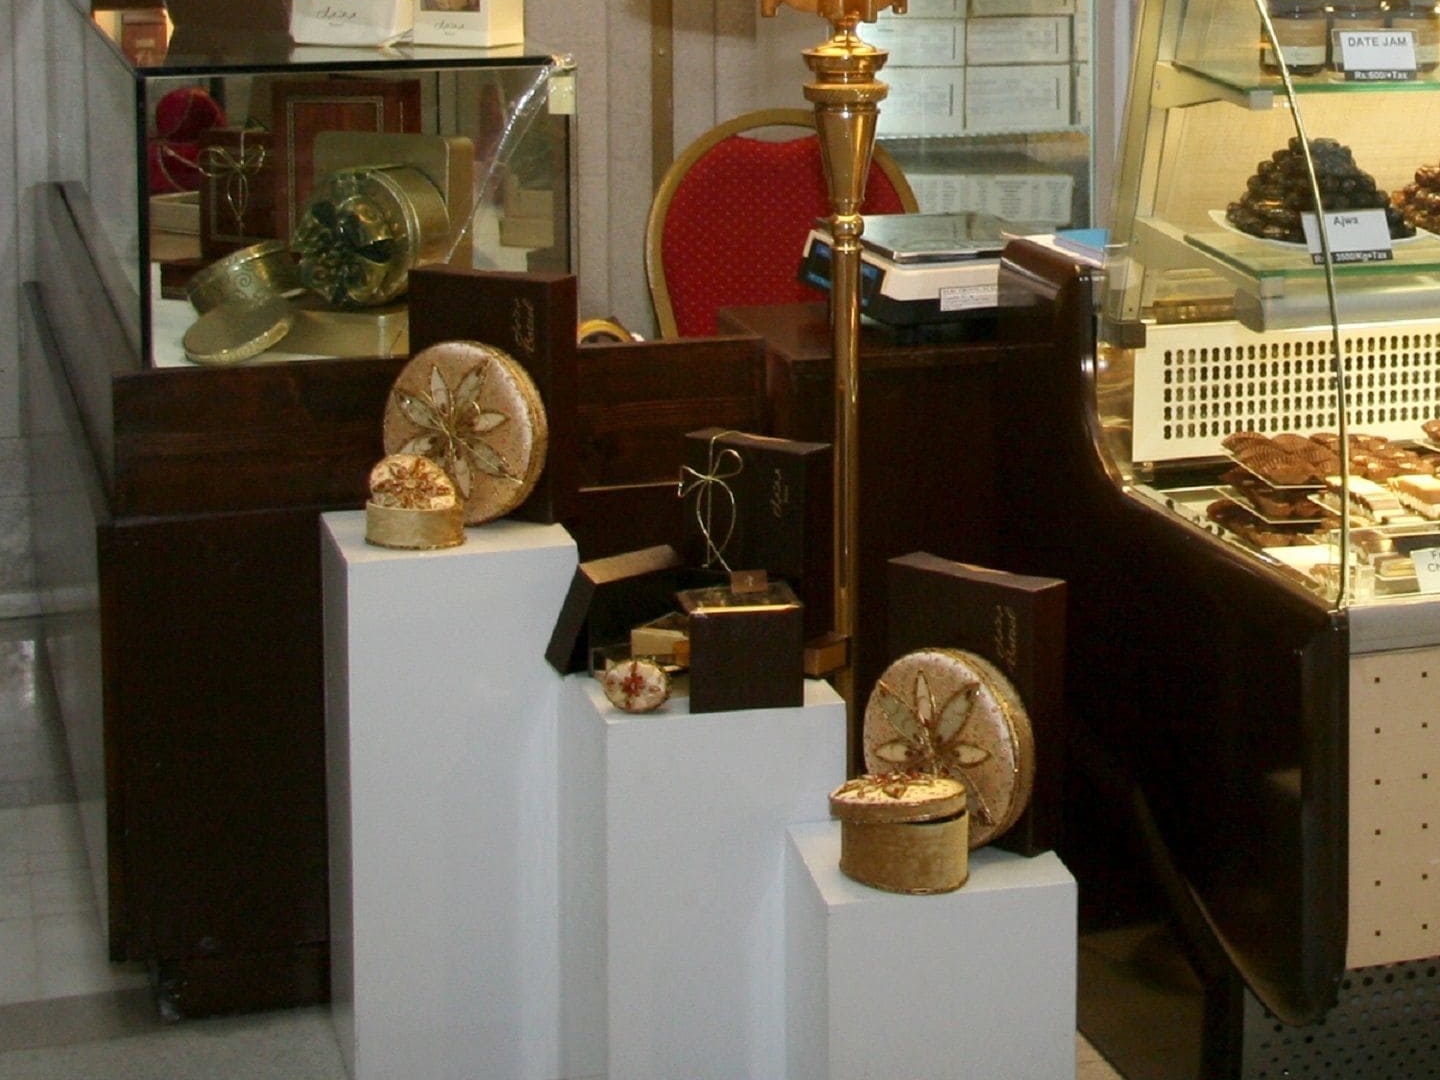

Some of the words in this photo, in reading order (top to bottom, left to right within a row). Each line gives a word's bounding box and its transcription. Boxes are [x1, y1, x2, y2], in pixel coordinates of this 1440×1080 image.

[1347, 36, 1380, 47] DATE
[1383, 36, 1407, 47] JAM
[1333, 216, 1360, 228] Ajwa
